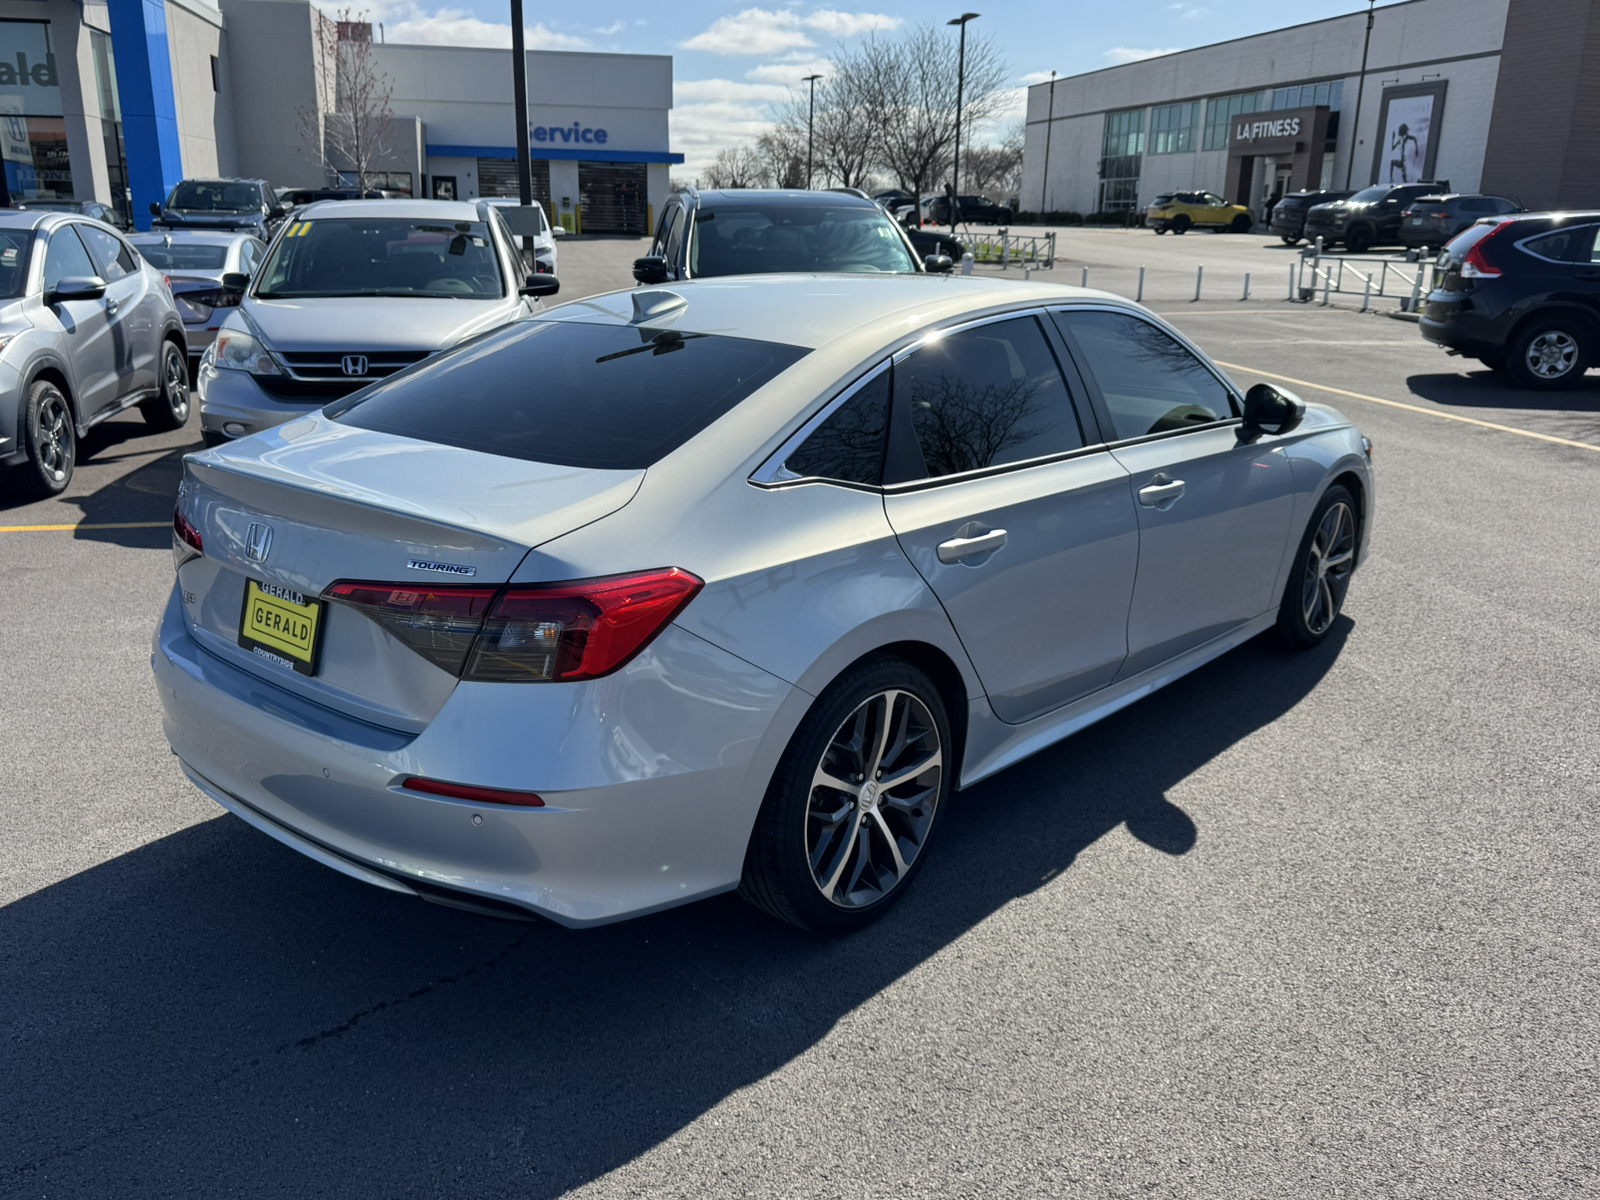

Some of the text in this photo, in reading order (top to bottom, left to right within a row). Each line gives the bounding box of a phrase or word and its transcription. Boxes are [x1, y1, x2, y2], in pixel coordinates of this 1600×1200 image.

[530, 121, 608, 144] ervice
[1236, 117, 1300, 140] LA FITNESS
[411, 560, 469, 575] TOURING
[261, 581, 304, 605] GERALD
[255, 607, 308, 641] GERALD
[253, 646, 295, 670] COUNTRYSIDE
